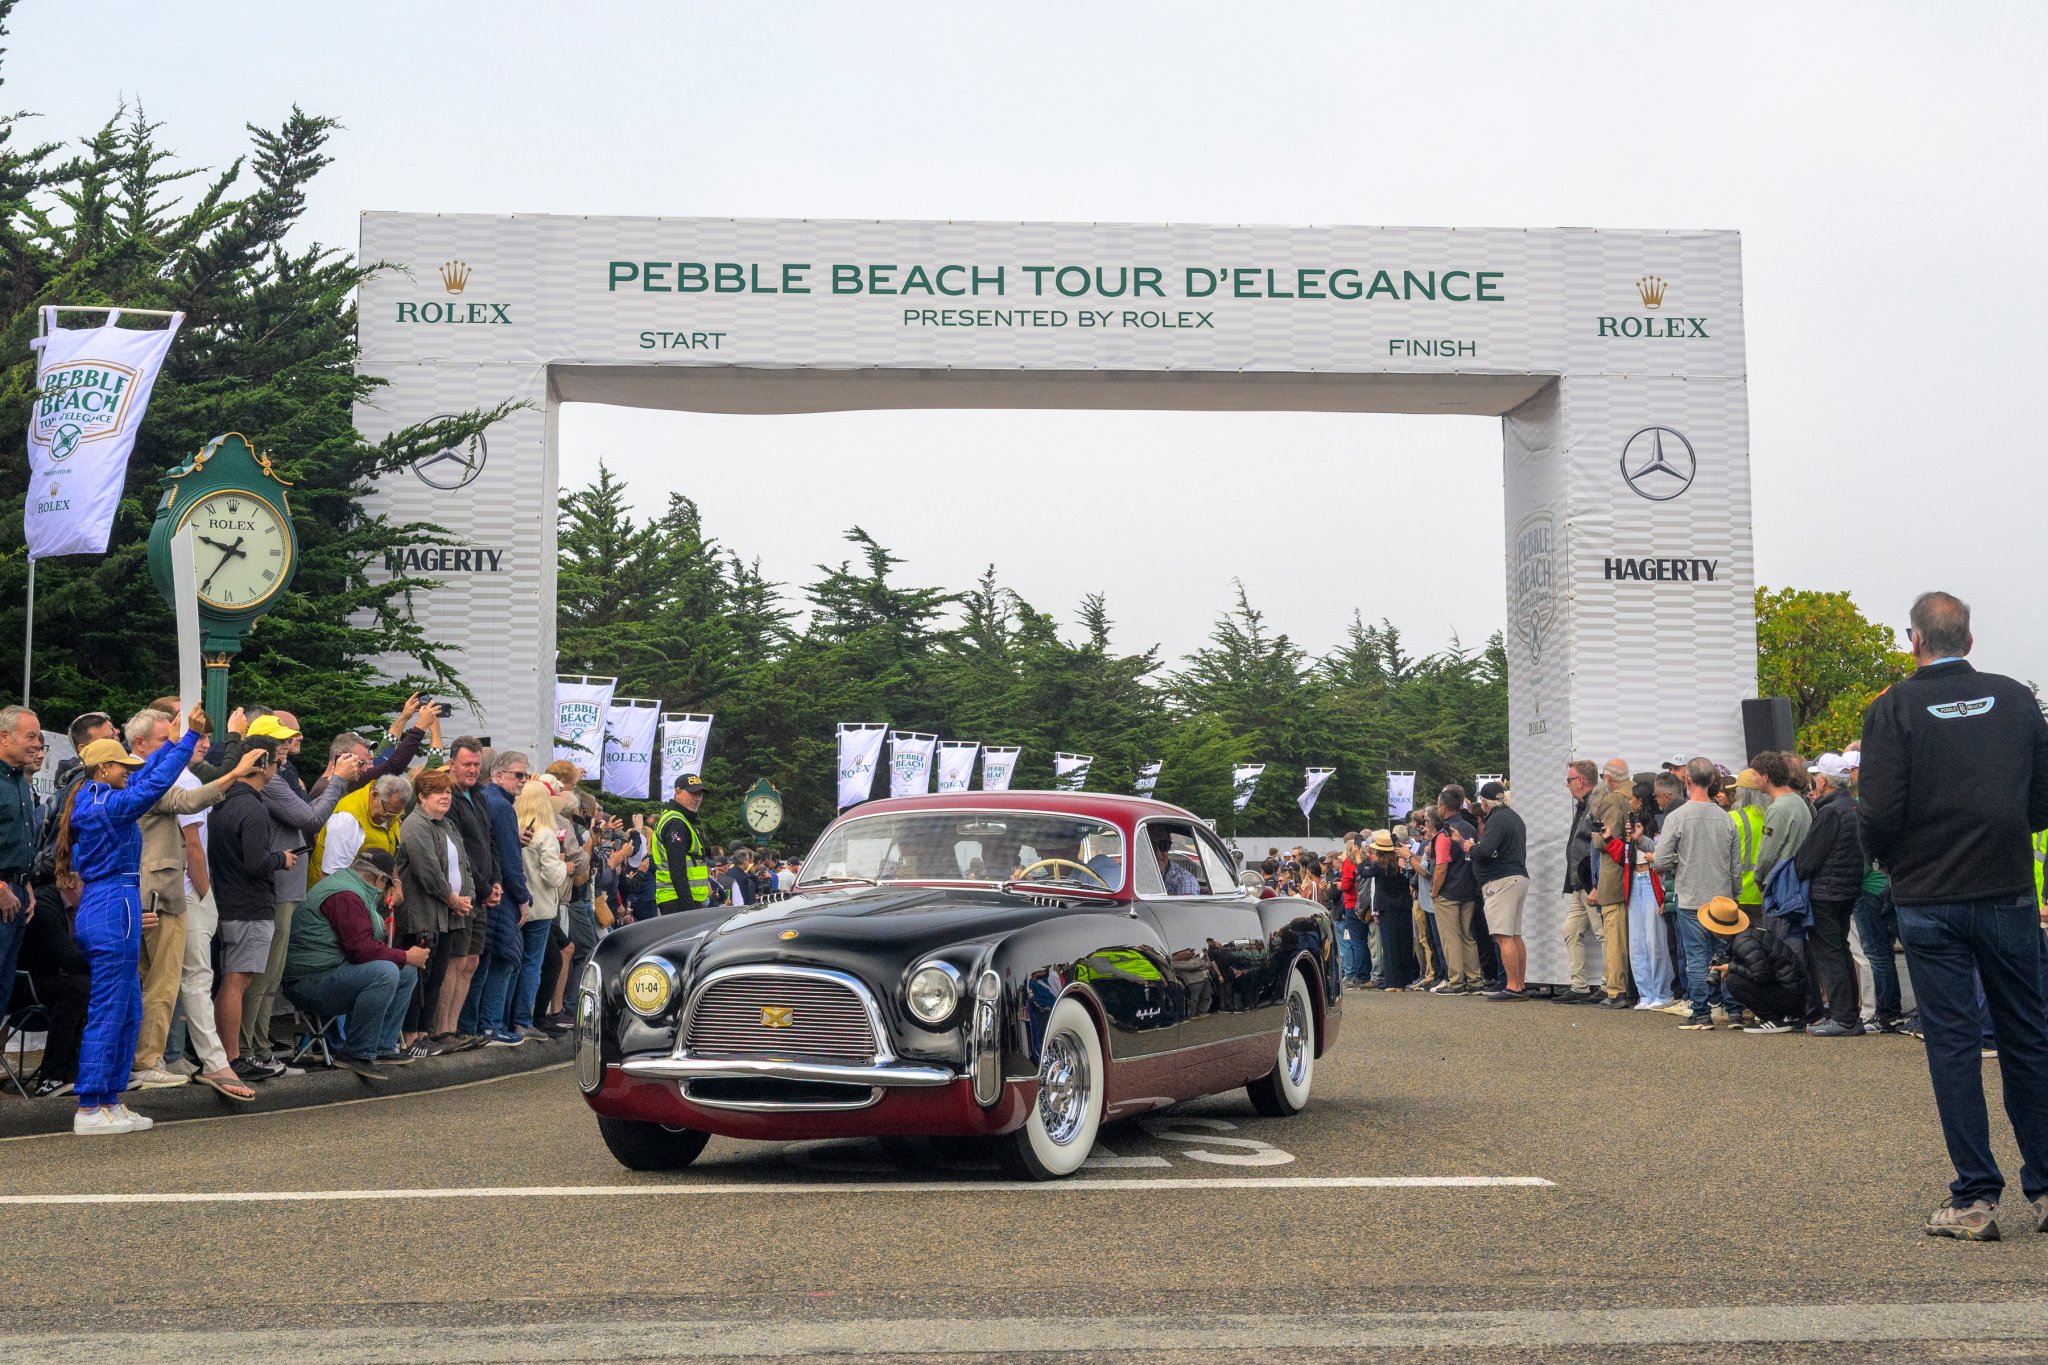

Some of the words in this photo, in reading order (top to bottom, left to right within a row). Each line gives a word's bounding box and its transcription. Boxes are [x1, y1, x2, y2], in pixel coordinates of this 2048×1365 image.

[609, 260, 811, 294] PEBBLE
[832, 263, 1005, 297] BEACH
[1022, 265, 1166, 299] TOUR
[1185, 267, 1505, 302] D'ELEGANCE
[395, 301, 513, 324] ROLEX
[904, 309, 1068, 328] PRESENTED
[1078, 310, 1114, 328] BY
[1122, 311, 1215, 329] ROLEX
[1597, 316, 1711, 338] ROLEX
[639, 331, 727, 350] START
[1388, 339, 1476, 357] FINISH
[44, 369, 129, 394] PEBBLE
[37, 499, 71, 514] ROLEX
[208, 519, 256, 531] ROLEX
[1518, 528, 1551, 567] PEBBLE
[384, 547, 503, 573] HAGERTY
[1604, 557, 1718, 582] HAGERTY
[1518, 559, 1551, 599] BEACH
[1528, 720, 1547, 736] ROLEX
[606, 752, 648, 763] ROLEX
[667, 745, 697, 756] BACH
[896, 753, 926, 762] PEBBLE
[841, 764, 871, 779] ROEX
[895, 760, 925, 769] BEACH
[32, 777, 55, 794] ROLE
[635, 982, 659, 993] V1-04
